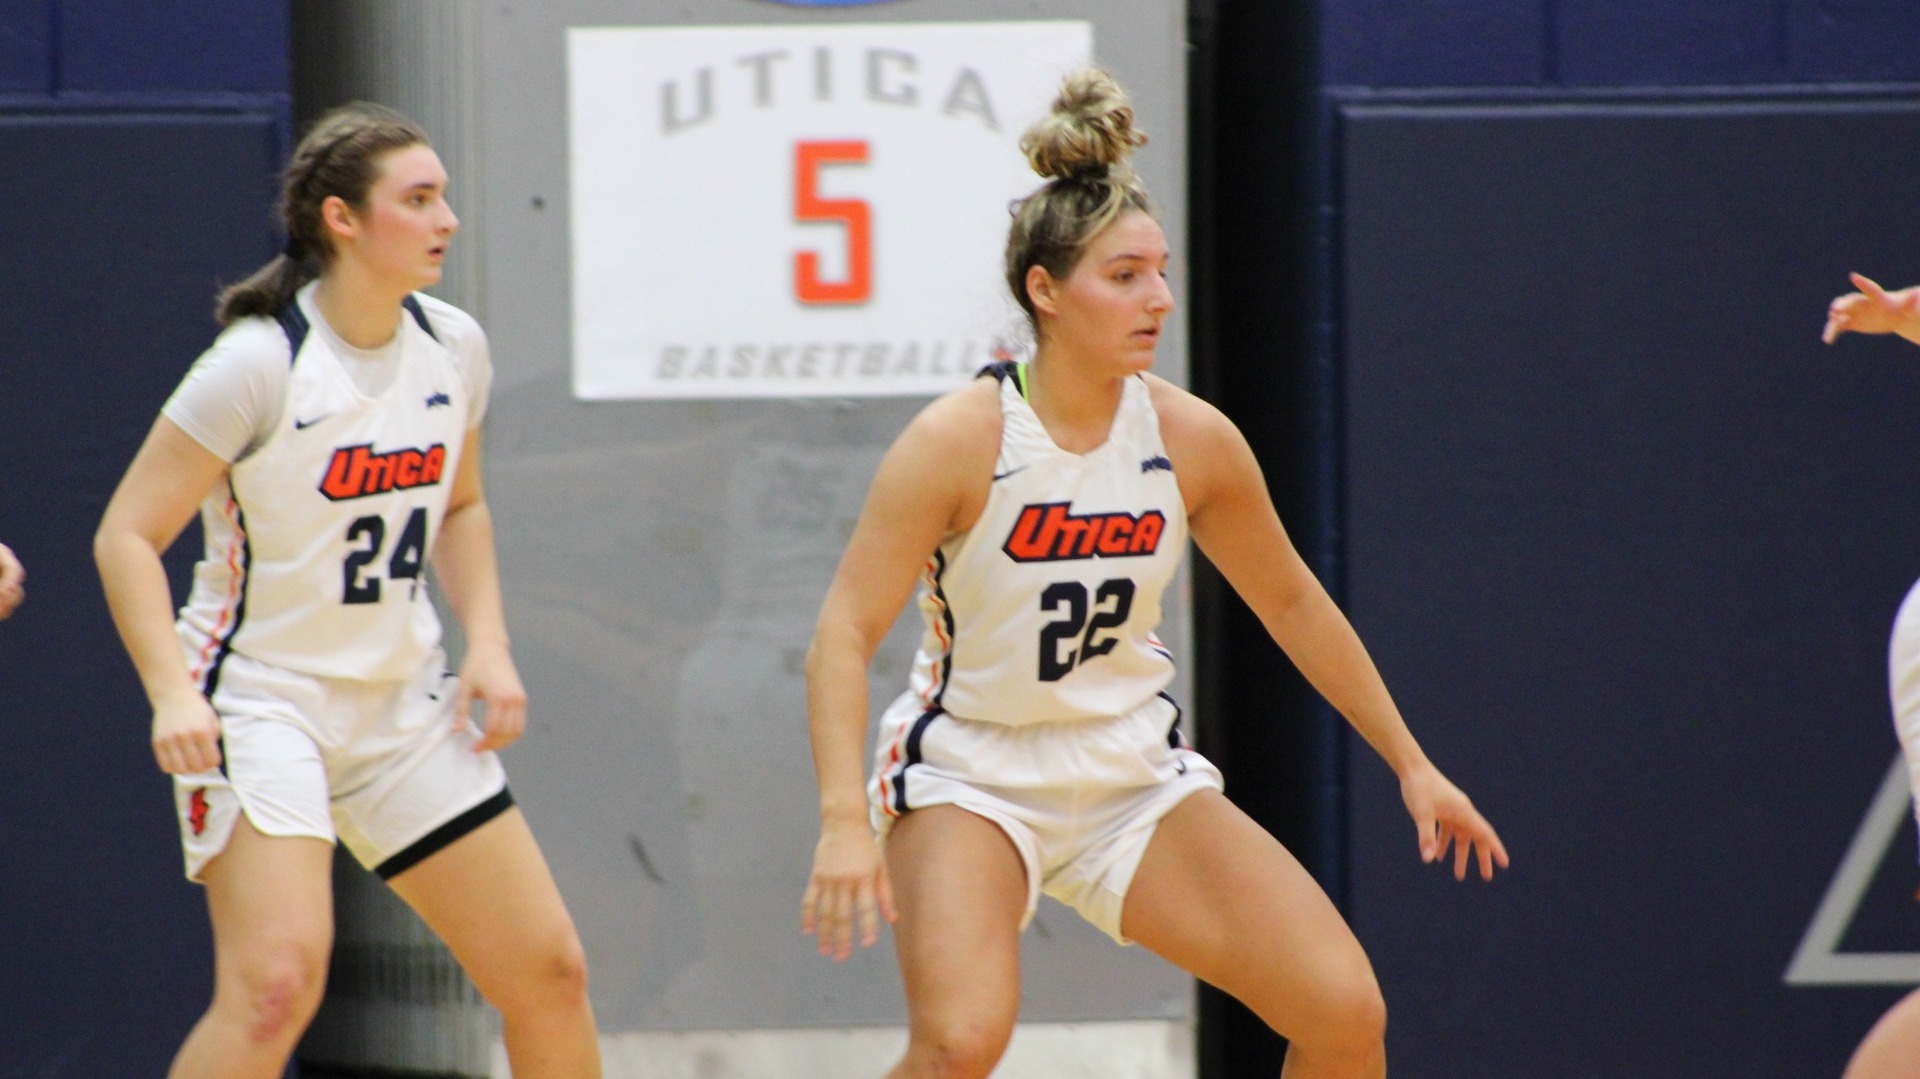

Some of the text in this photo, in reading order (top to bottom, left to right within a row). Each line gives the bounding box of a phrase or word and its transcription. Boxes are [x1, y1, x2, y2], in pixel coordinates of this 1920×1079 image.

[658, 46, 1001, 135] UTICA
[793, 139, 873, 305] 5
[656, 342, 980, 380] BASKETBALL
[318, 441, 446, 502] UTICA
[341, 506, 428, 605] 24
[1002, 501, 1166, 563] UTICA
[1038, 577, 1136, 682] 22
